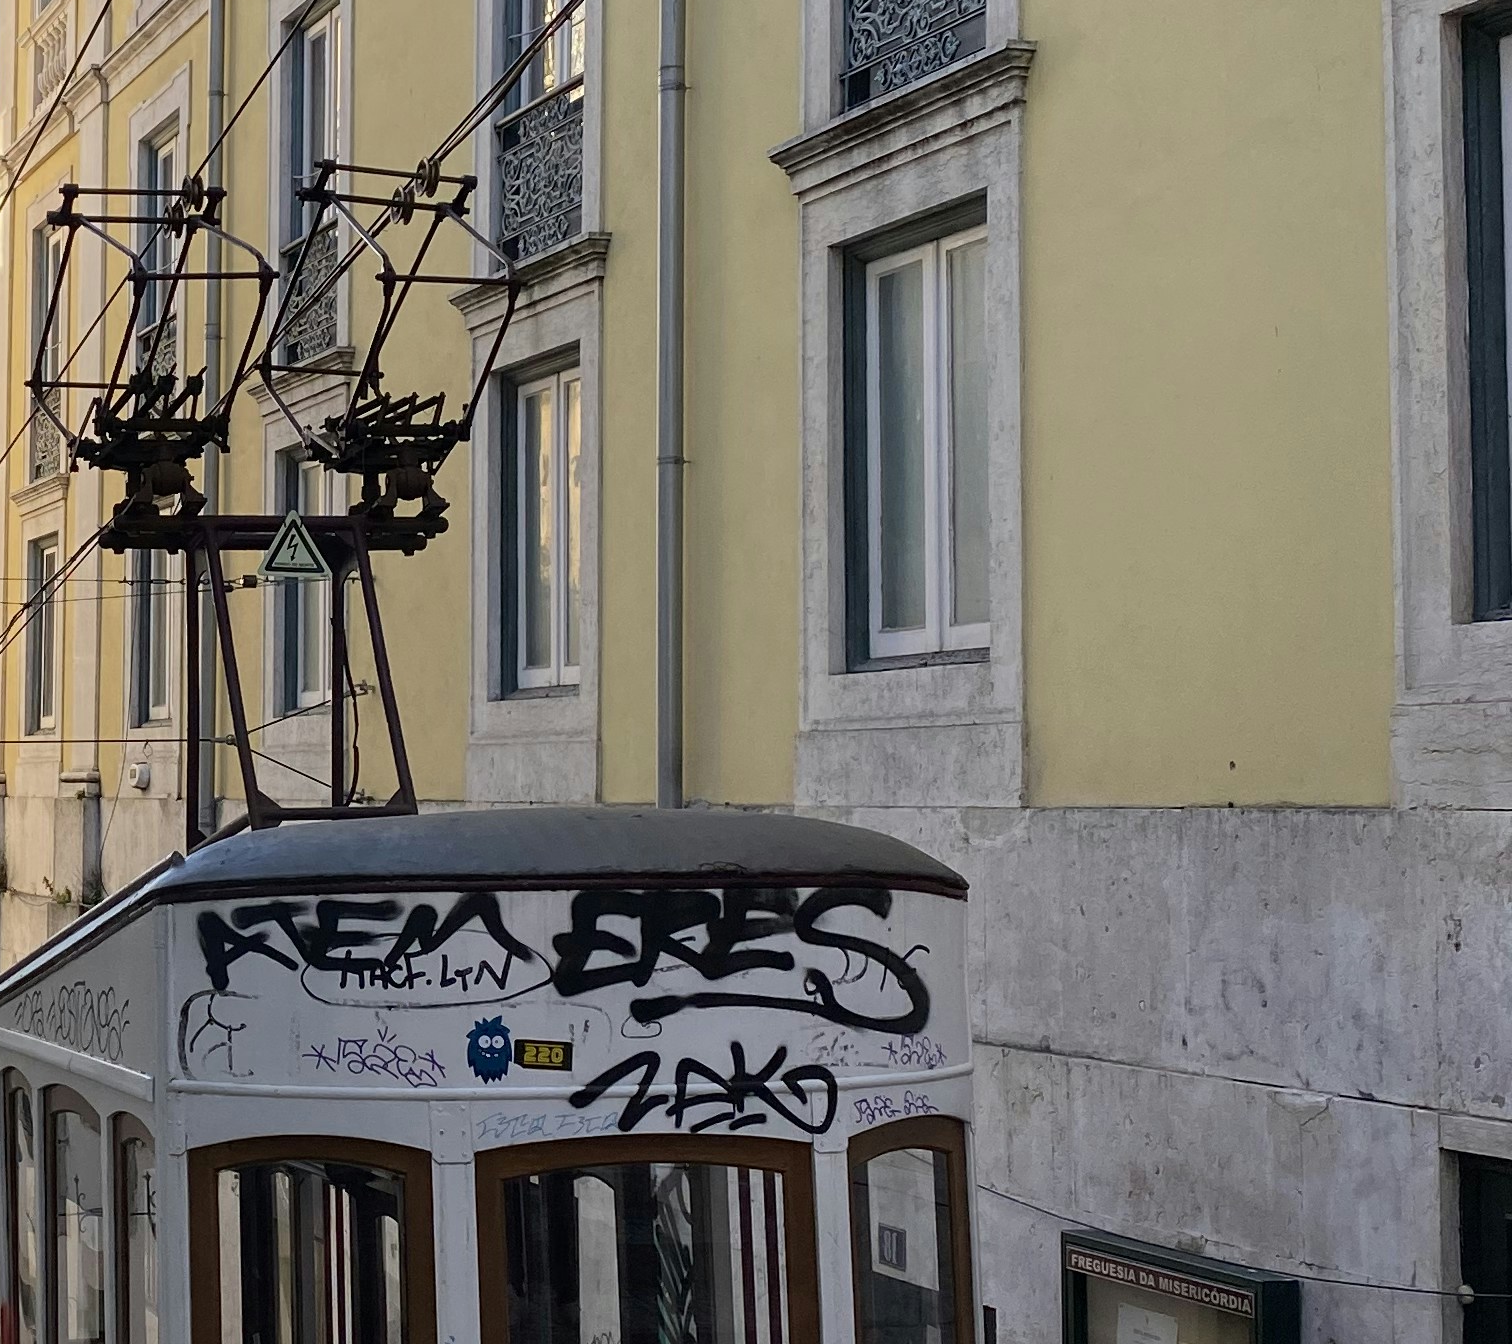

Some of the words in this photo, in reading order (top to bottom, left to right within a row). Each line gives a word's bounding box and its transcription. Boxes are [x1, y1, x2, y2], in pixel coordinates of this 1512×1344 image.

[523, 1044, 565, 1066] 220
[1071, 1253, 1137, 1283] FREGUESIA
[1139, 1272, 1156, 1287] DA
[1158, 1276, 1252, 1314] MISERICÓRDIA
